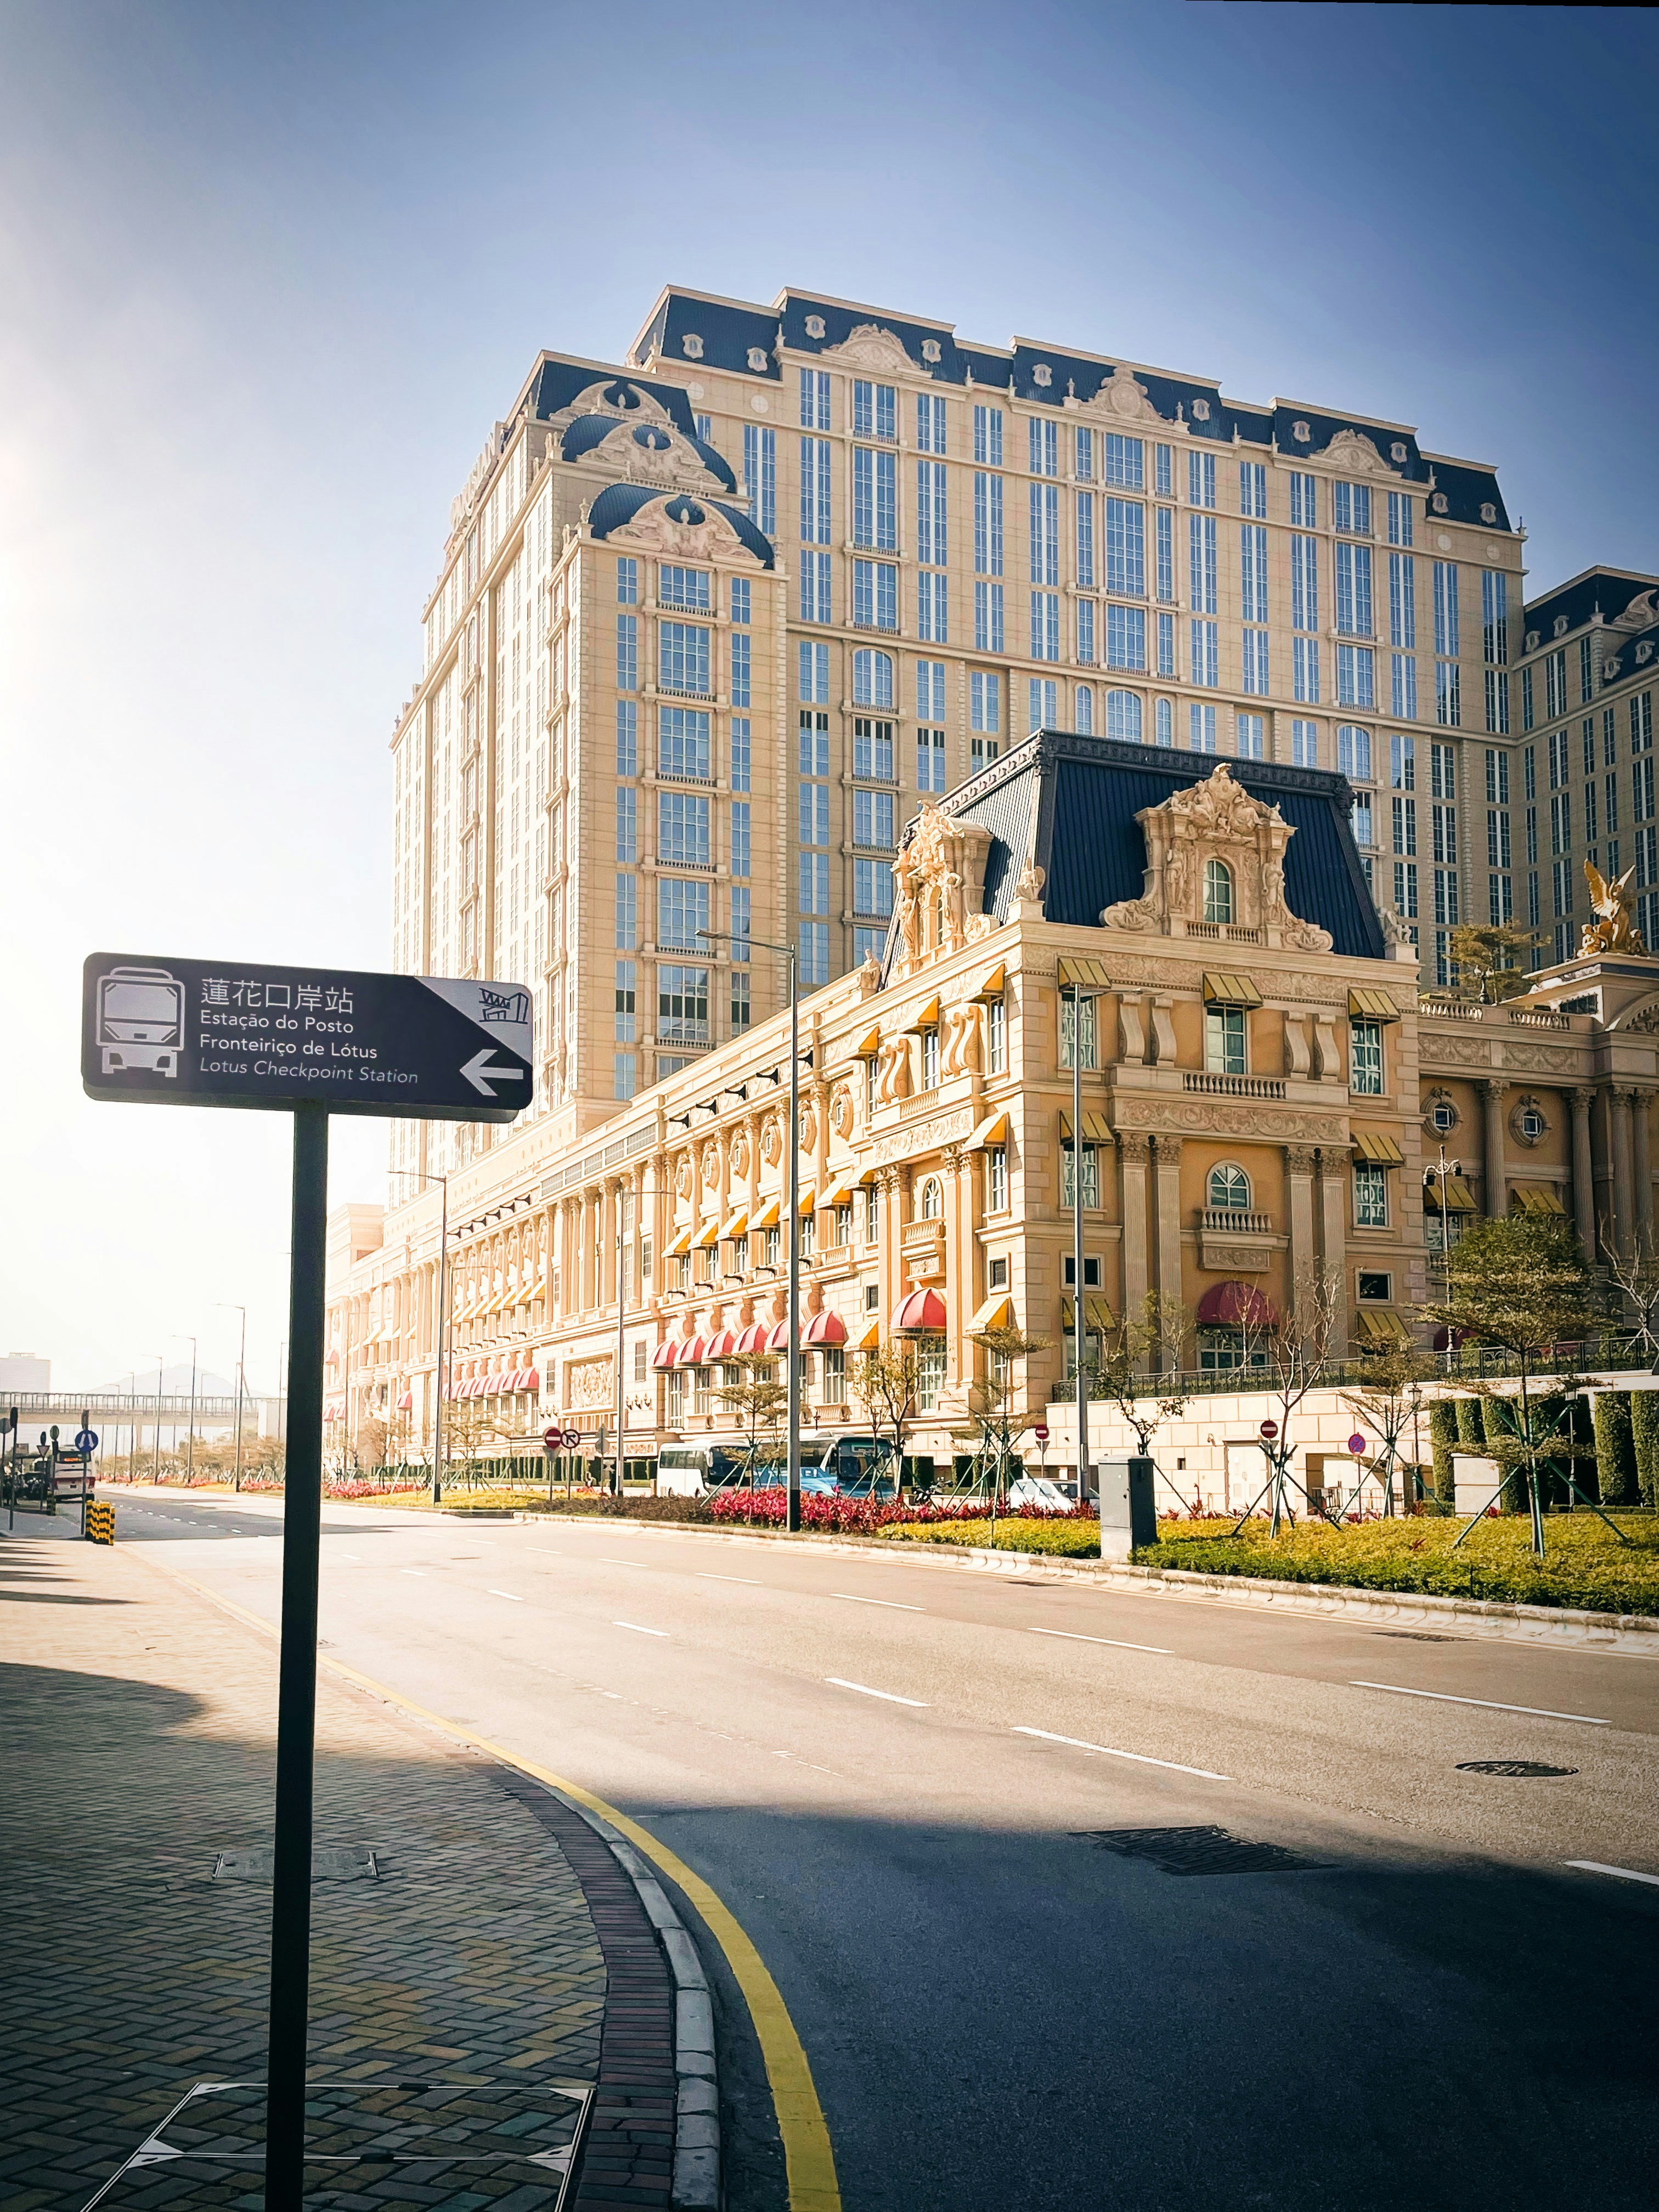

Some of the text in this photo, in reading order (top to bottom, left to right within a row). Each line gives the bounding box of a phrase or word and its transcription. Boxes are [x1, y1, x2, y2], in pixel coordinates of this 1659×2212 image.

[201, 978, 353, 1014] 蓮花口岸站
[201, 1009, 353, 1033] Estação do Posto
[200, 1034, 377, 1059] Fronteiriço de Lótus
[200, 1057, 418, 1084] Lotus Checkpoint Station
